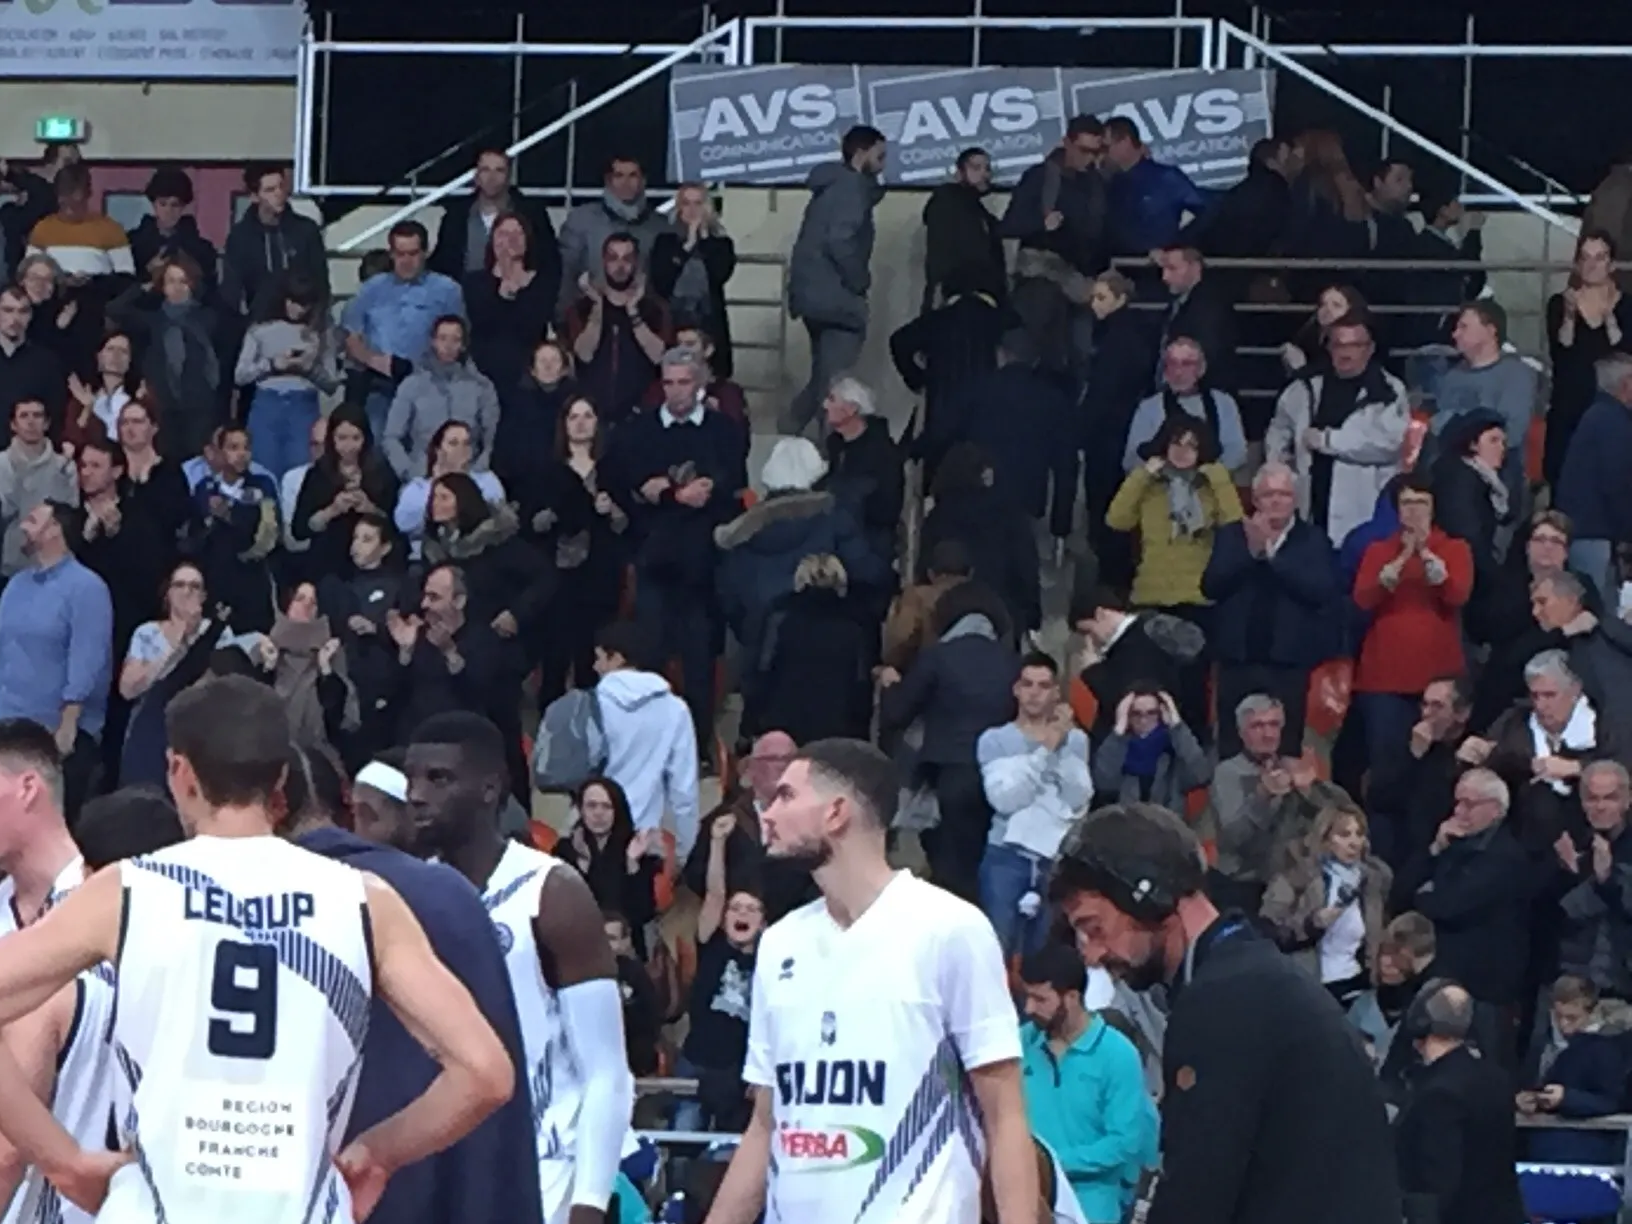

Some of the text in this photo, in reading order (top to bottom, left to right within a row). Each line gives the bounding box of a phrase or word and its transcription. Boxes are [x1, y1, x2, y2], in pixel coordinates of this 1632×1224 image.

[699, 84, 836, 141] AVS
[899, 87, 1038, 144] AVS
[1111, 88, 1244, 144] AVS
[184, 886, 315, 930] LELOUP
[208, 939, 278, 1060] 9
[185, 1116, 295, 1137] BOURGOGNE
[223, 1098, 292, 1114] REGION
[185, 1162, 242, 1179] COMTE
[199, 1140, 279, 1158] FRANCHE
